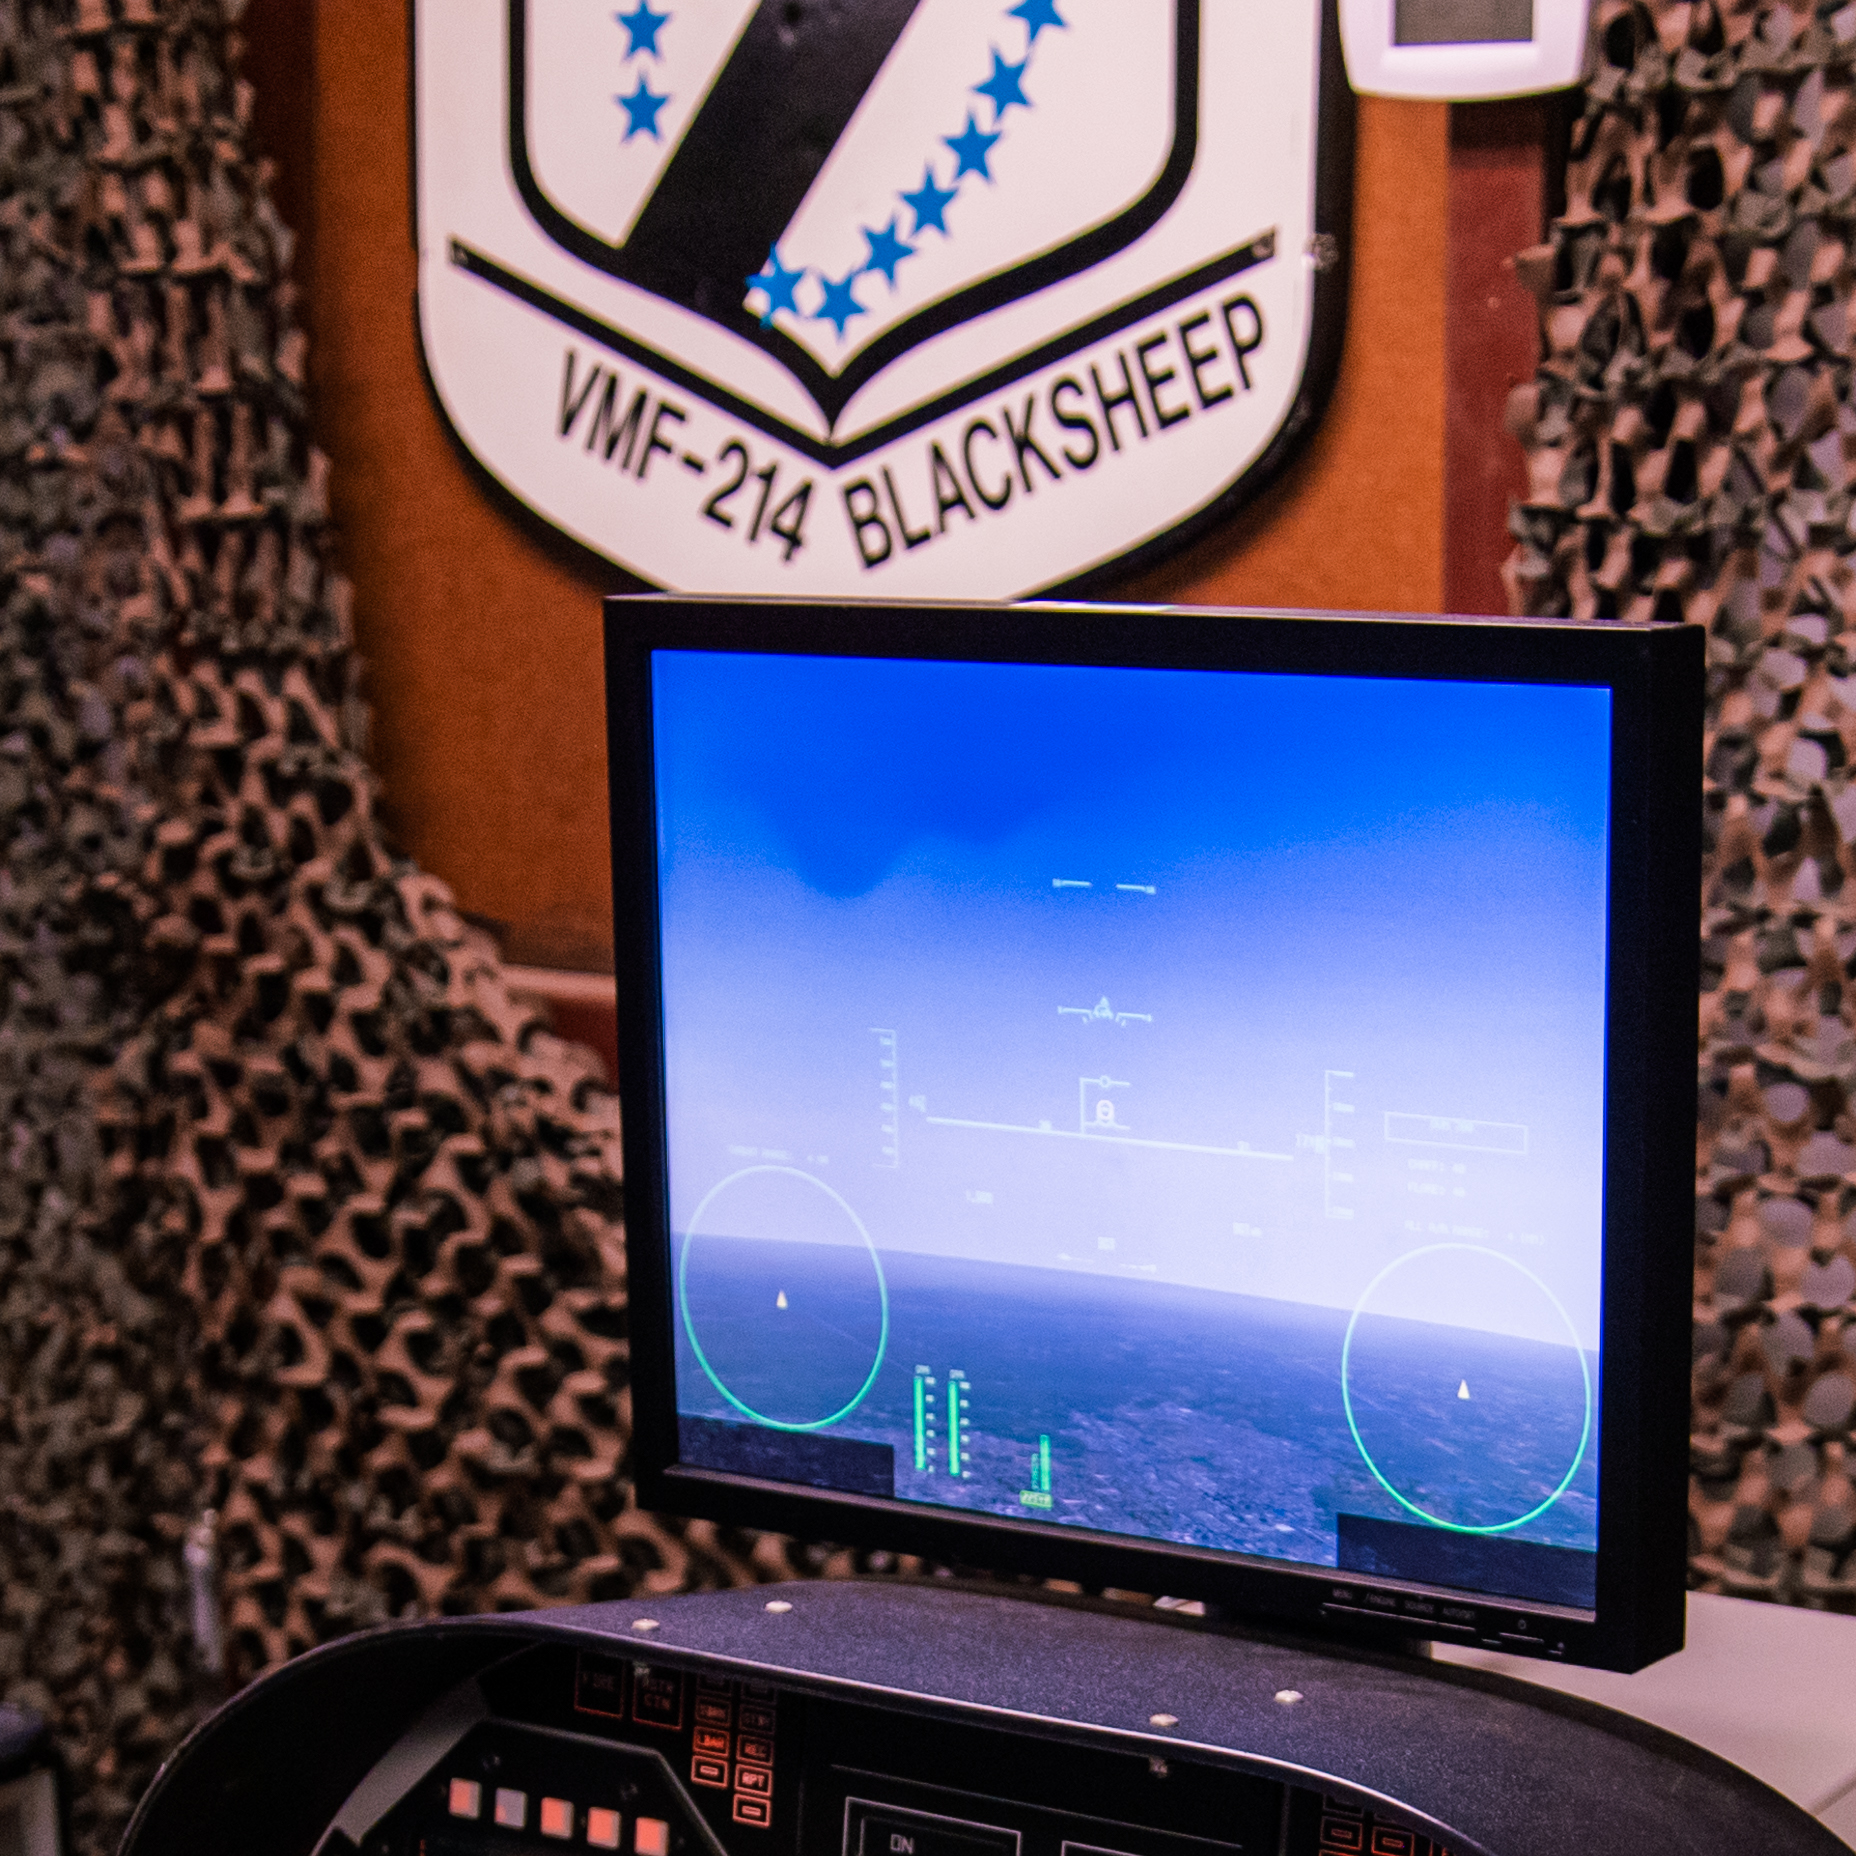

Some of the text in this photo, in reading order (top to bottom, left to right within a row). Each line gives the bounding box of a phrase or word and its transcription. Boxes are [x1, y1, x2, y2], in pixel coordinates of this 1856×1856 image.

[555, 292, 1266, 571] VMF-214 BLACKSHEEP
[890, 1833, 915, 1855] ON
